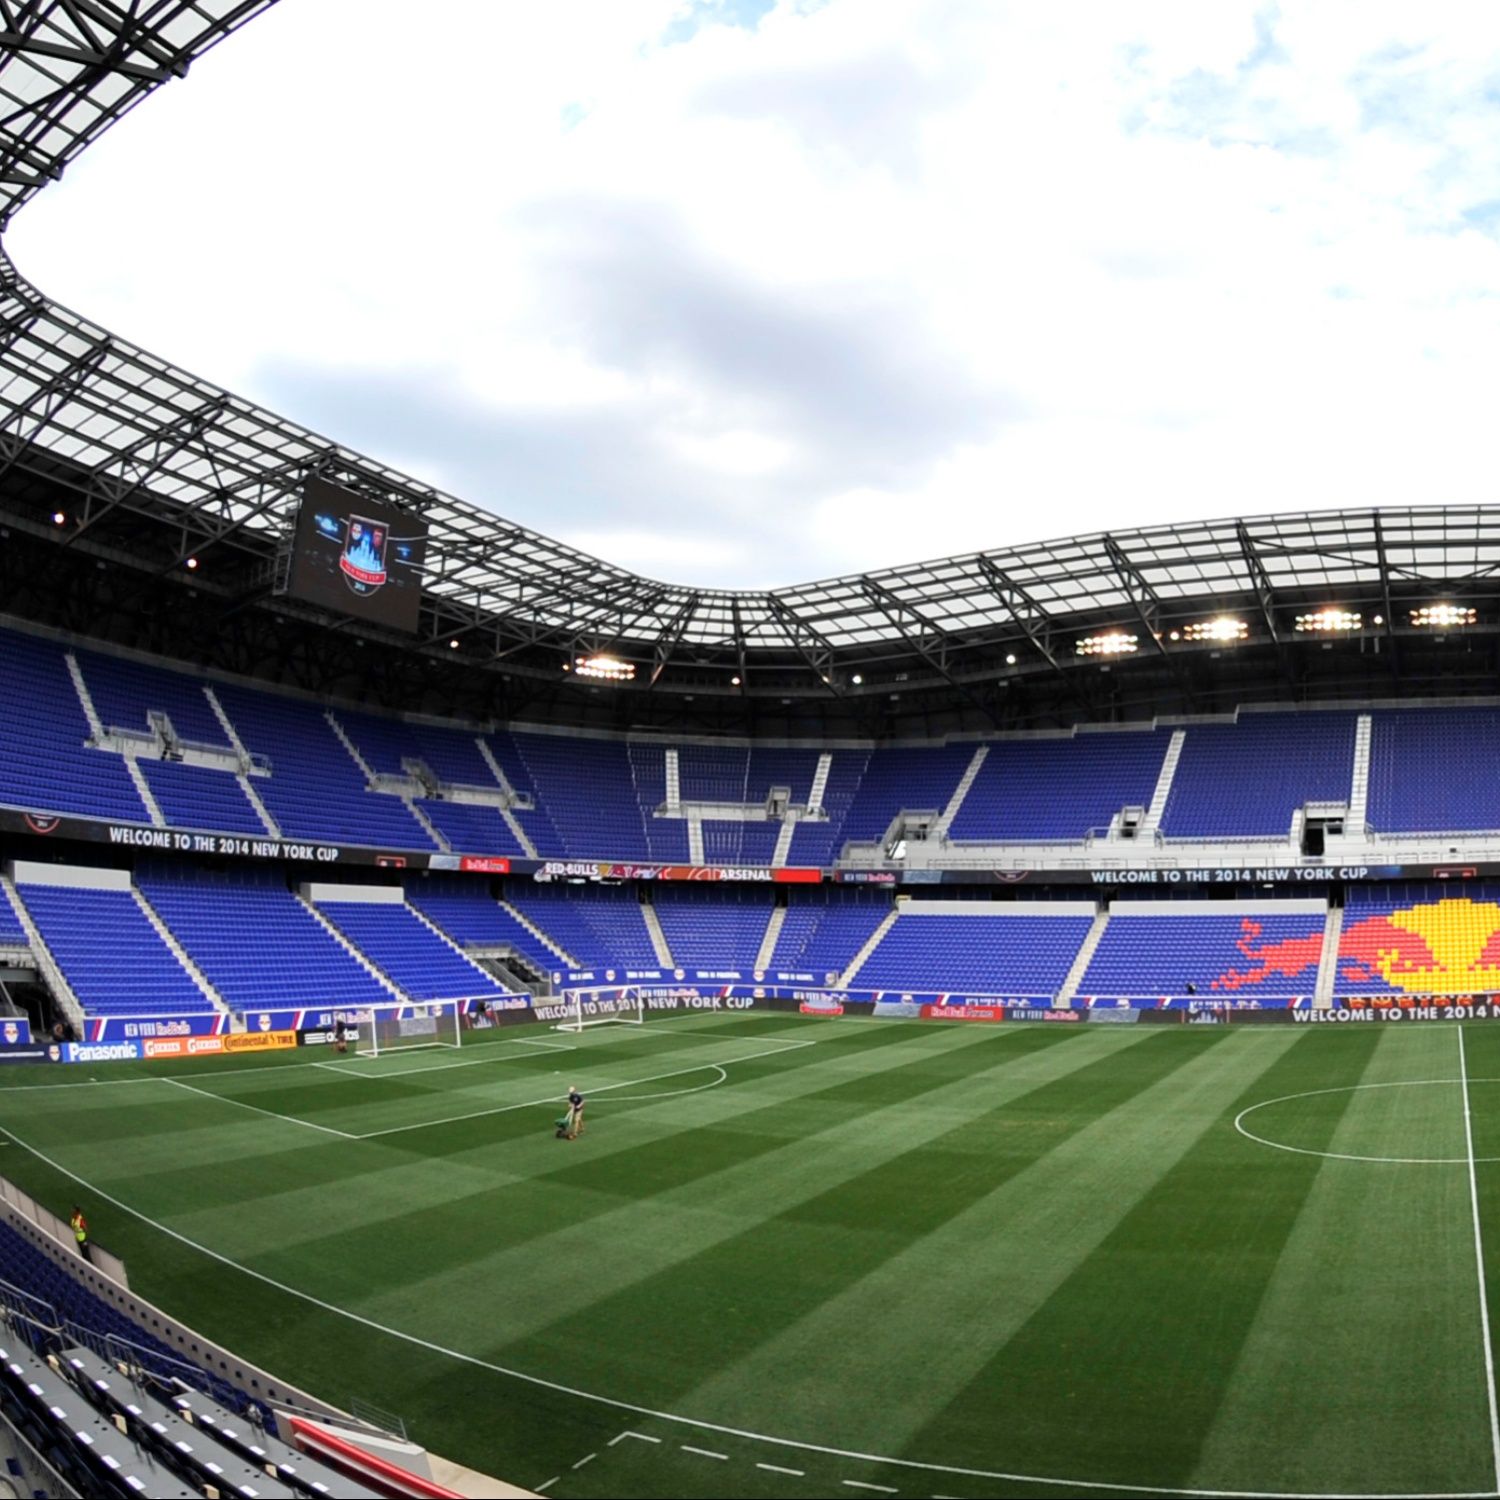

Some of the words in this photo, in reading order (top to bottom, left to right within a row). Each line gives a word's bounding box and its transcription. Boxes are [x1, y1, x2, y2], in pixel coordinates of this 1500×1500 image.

[109, 826, 170, 848] WELCOME
[174, 834, 190, 850] TO
[194, 836, 215, 851] THE
[219, 839, 249, 855] 2014
[252, 842, 280, 857] NEW
[282, 845, 314, 859] YORK
[317, 847, 338, 861] CUP
[719, 868, 773, 880] ARSENAL
[1091, 870, 1157, 883] WELCOME
[1162, 870, 1180, 882] TO
[1185, 870, 1210, 881] THE
[1215, 870, 1251, 881] 2014
[1256, 869, 1289, 880] NEW
[1294, 868, 1334, 880] YORK
[1339, 867, 1368, 879] CUP
[535, 1003, 582, 1020] WELCOM
[583, 1002, 597, 1014] TO
[599, 1000, 616, 1013] THE
[648, 999, 677, 1009] NEW
[682, 997, 721, 1008] YORK
[726, 997, 754, 1009] CUP
[1293, 1008, 1374, 1022] WELCOME
[1380, 1008, 1402, 1020] TO
[1408, 1007, 1437, 1019] THE
[1444, 1005, 1487, 1019] 2014
[224, 1034, 269, 1051] Continental
[68, 1041, 138, 1062] Panasonic
